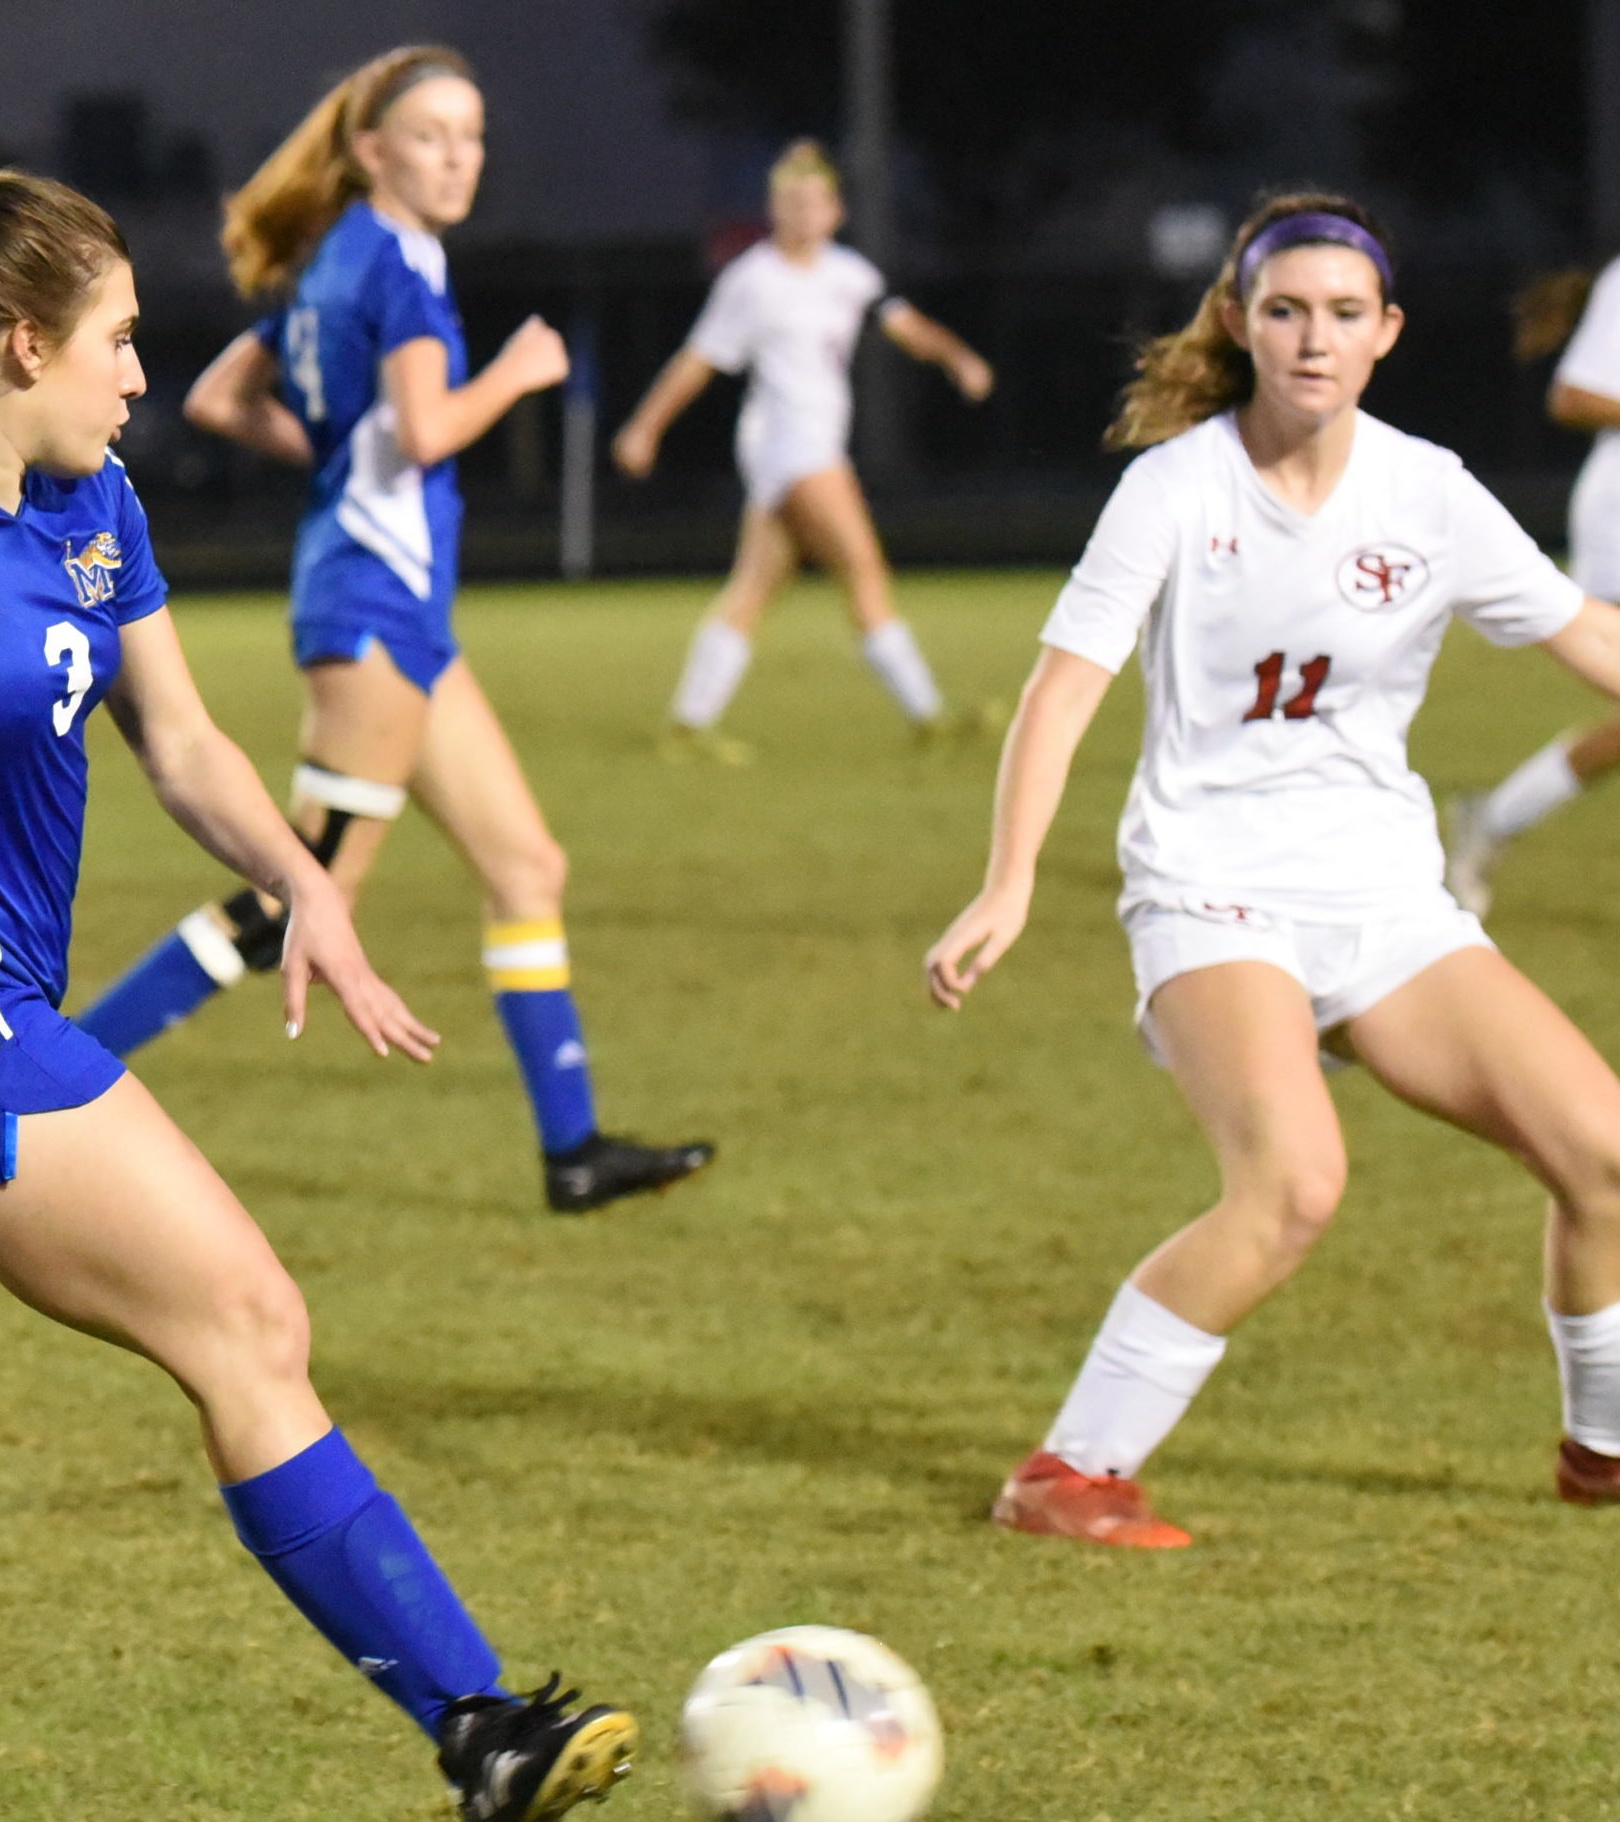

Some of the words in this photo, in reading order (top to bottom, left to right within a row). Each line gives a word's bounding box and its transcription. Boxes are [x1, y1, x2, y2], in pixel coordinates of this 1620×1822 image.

[64, 558, 115, 608] M
[43, 621, 94, 737] 3
[1241, 651, 1332, 722] 11
